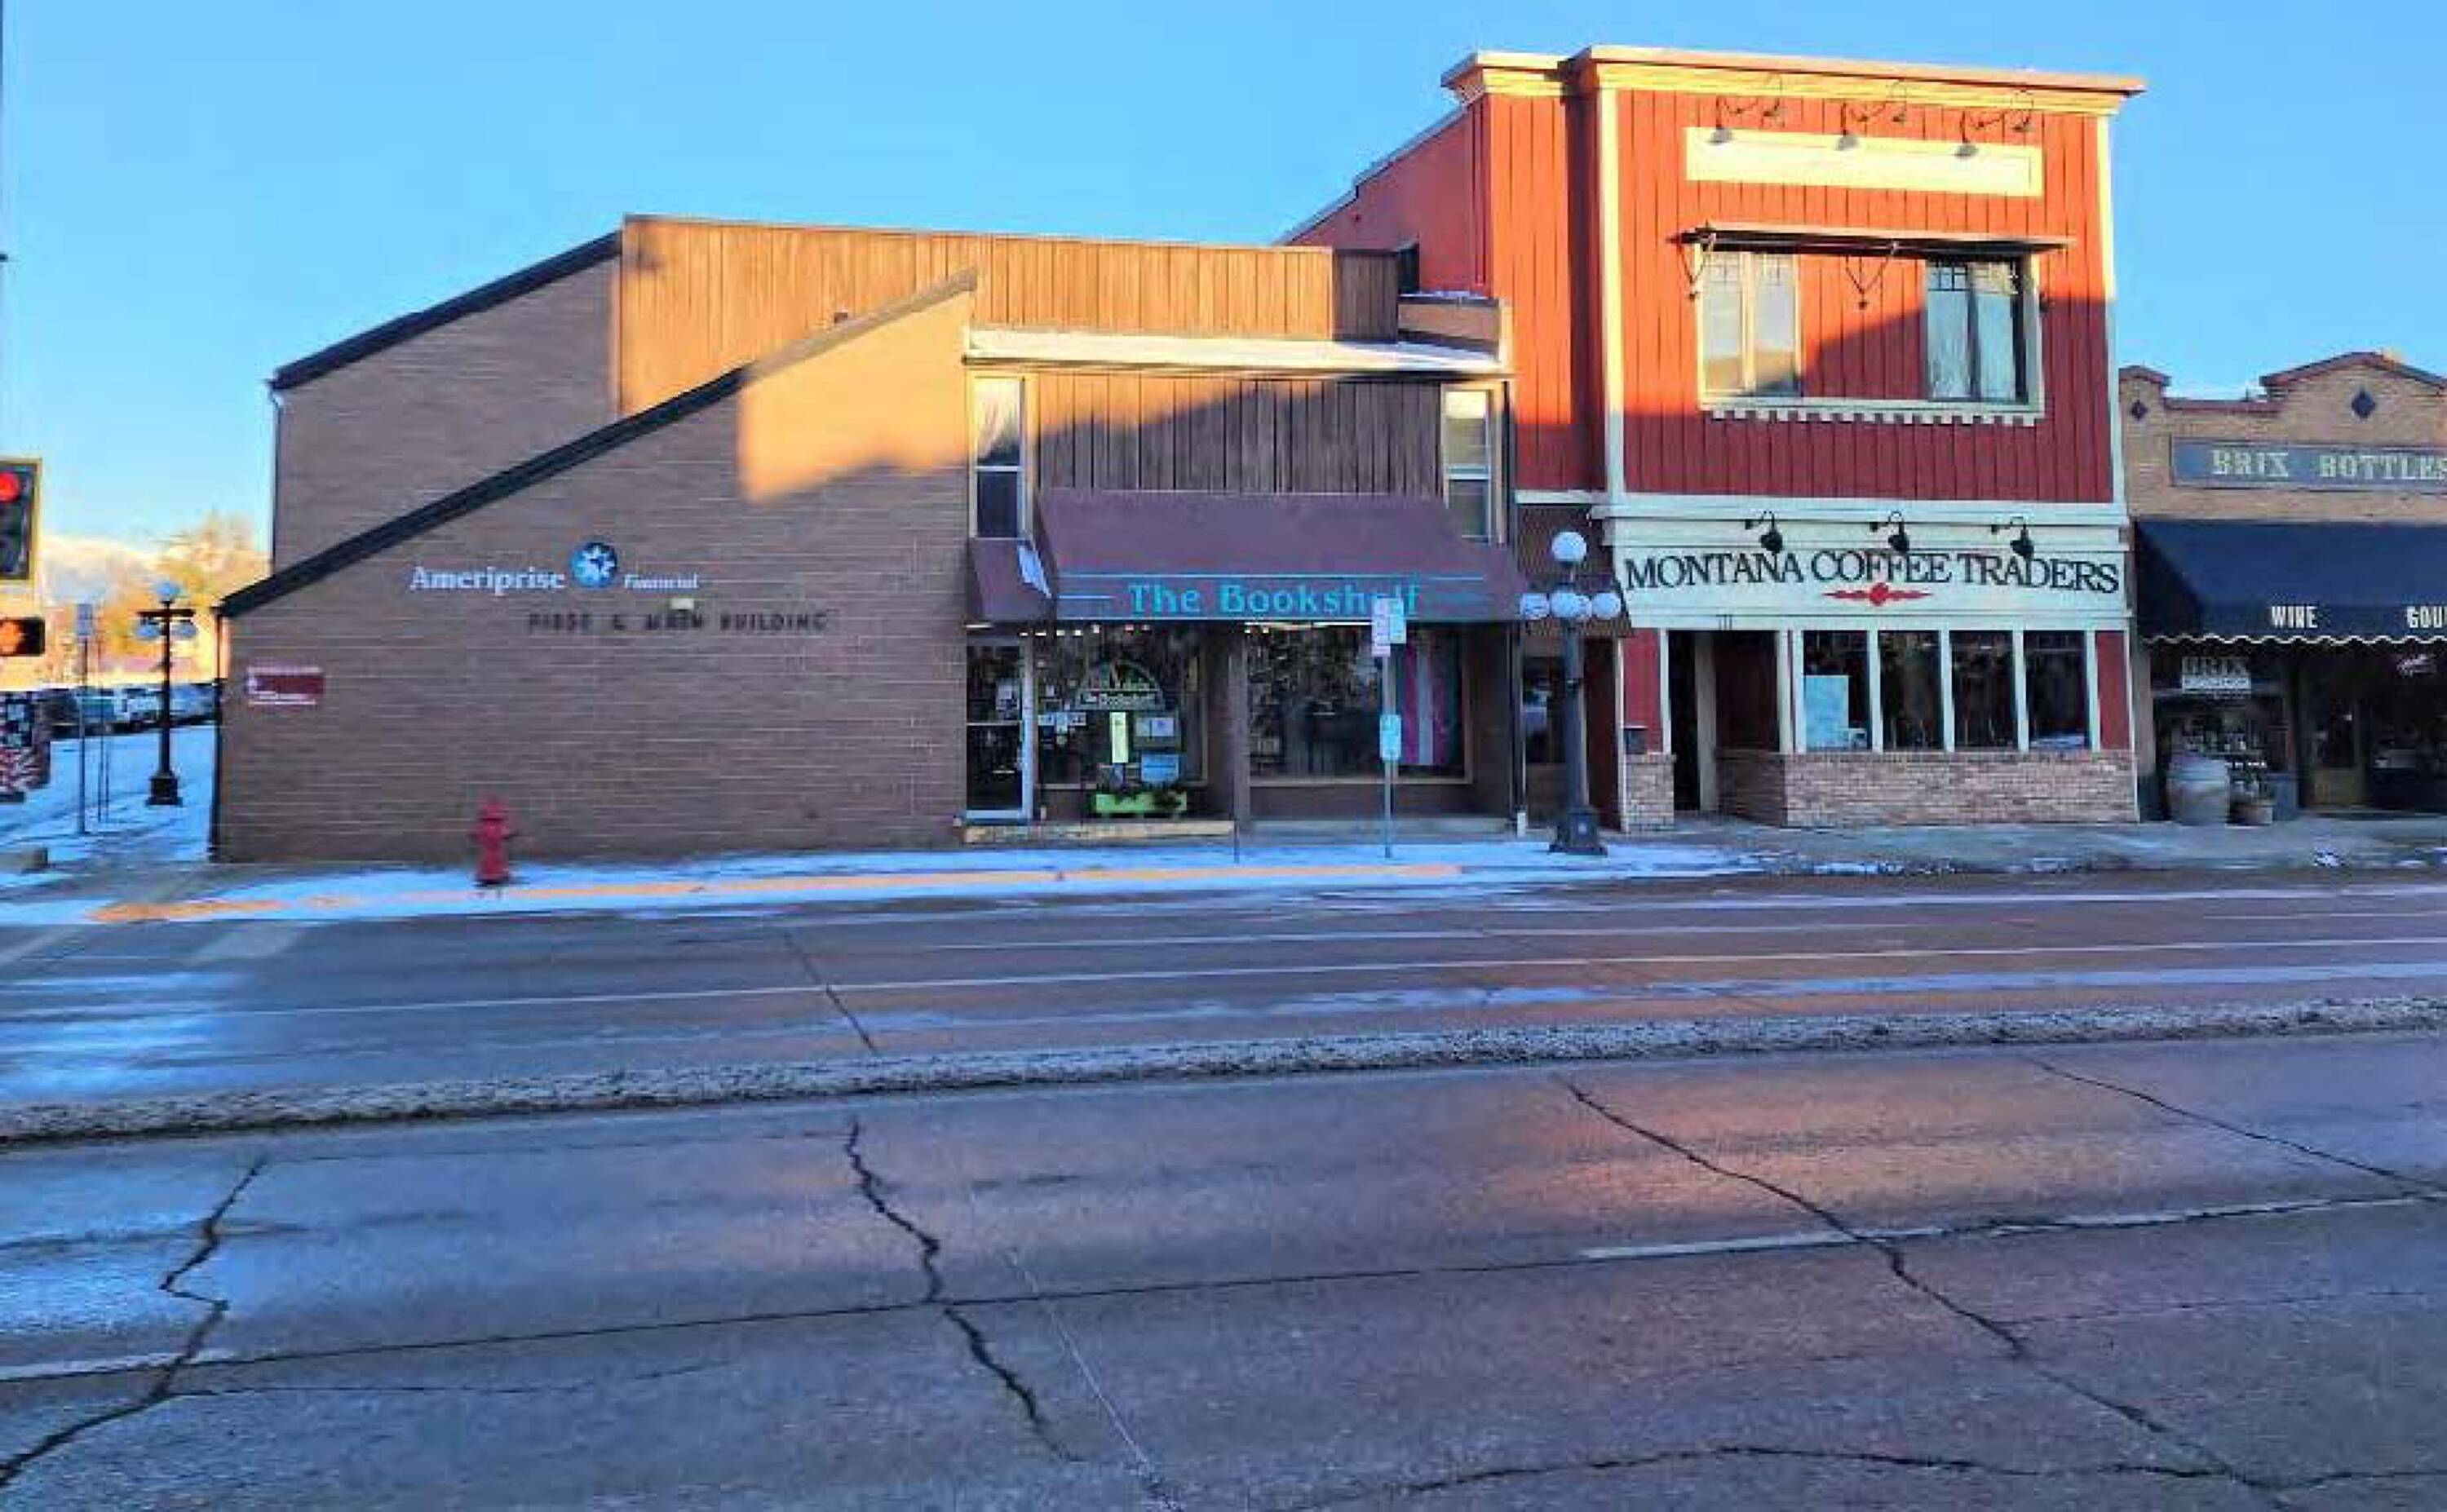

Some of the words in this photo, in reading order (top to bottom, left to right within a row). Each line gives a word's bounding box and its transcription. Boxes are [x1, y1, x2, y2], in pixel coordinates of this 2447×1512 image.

[2211, 449, 2289, 478] BRIX
[409, 565, 565, 598] Ameriprise
[1624, 551, 1804, 590] MONTANA
[1811, 550, 1952, 584] COFFEE
[1959, 553, 2119, 594] TRADERS
[1129, 583, 1201, 615] The
[1221, 577, 1420, 615] Bookshlf
[719, 612, 829, 631] BUILDING
[2272, 605, 2318, 628] WINE
[2406, 605, 2447, 628] GOU
